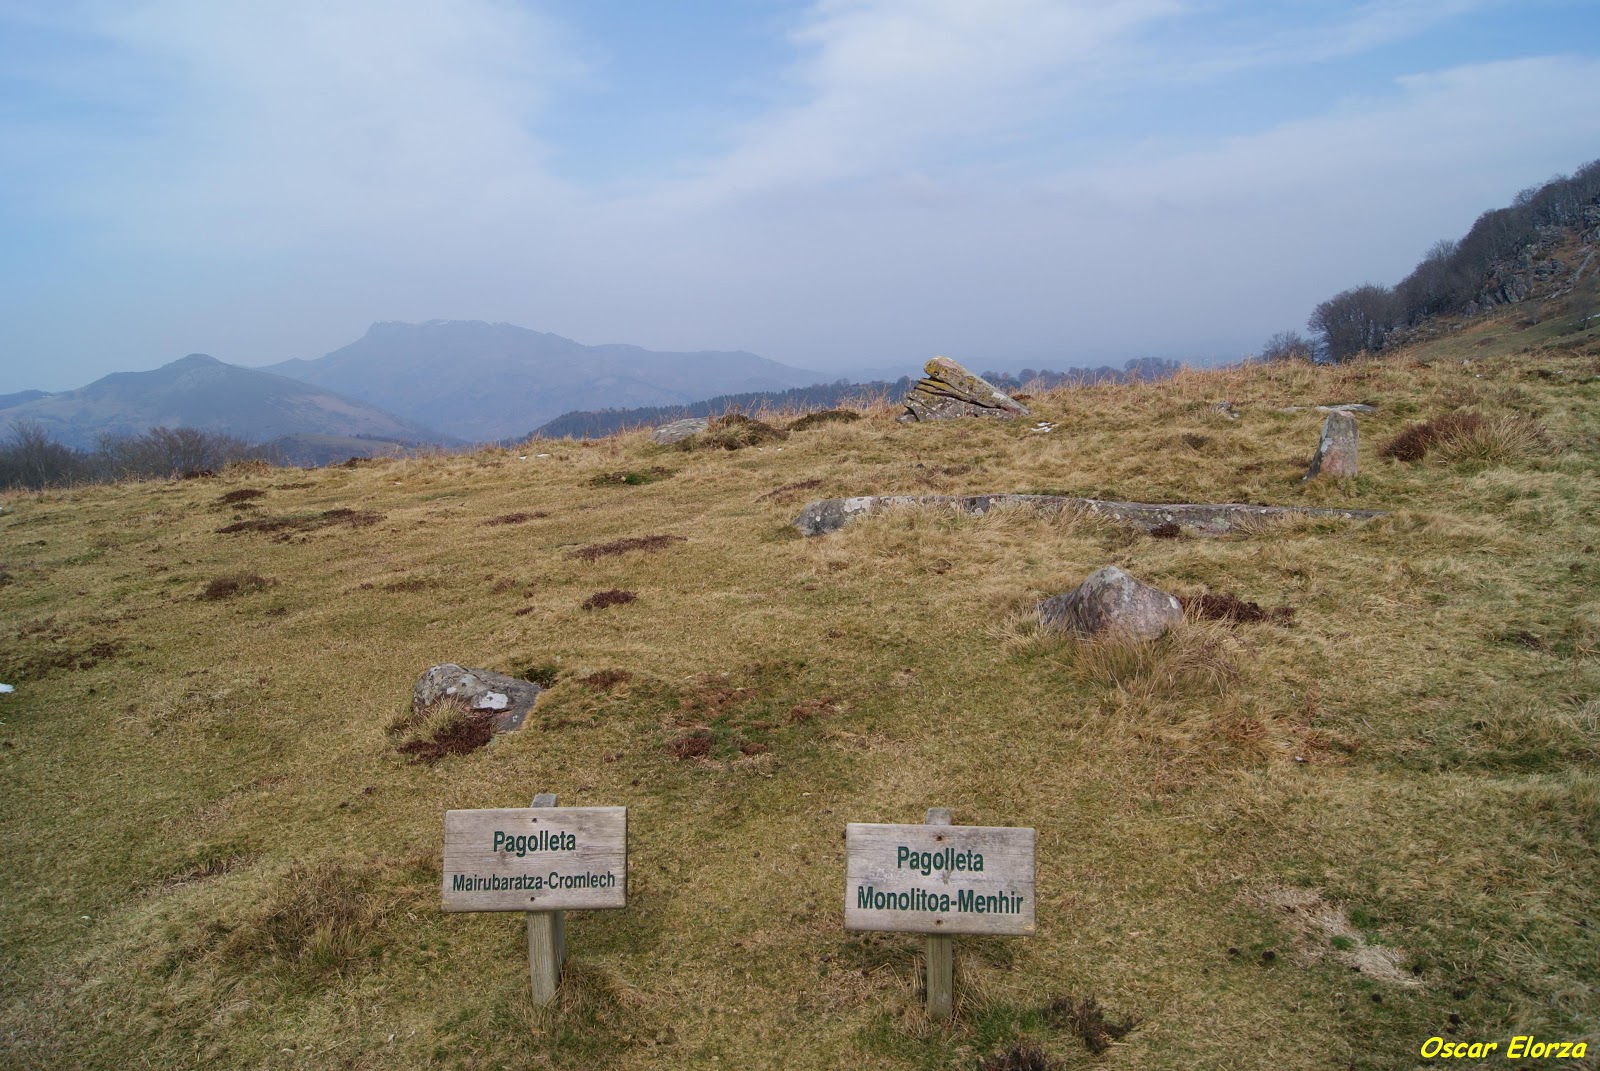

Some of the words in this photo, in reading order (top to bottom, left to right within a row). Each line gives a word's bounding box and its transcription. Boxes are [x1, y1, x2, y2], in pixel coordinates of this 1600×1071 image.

[493, 830, 576, 857] Pagolleta
[897, 846, 984, 876] Pagolleta
[452, 870, 616, 892] Mairubaratza-Cromlech
[857, 885, 1024, 914] Monolitoa-Menhir
